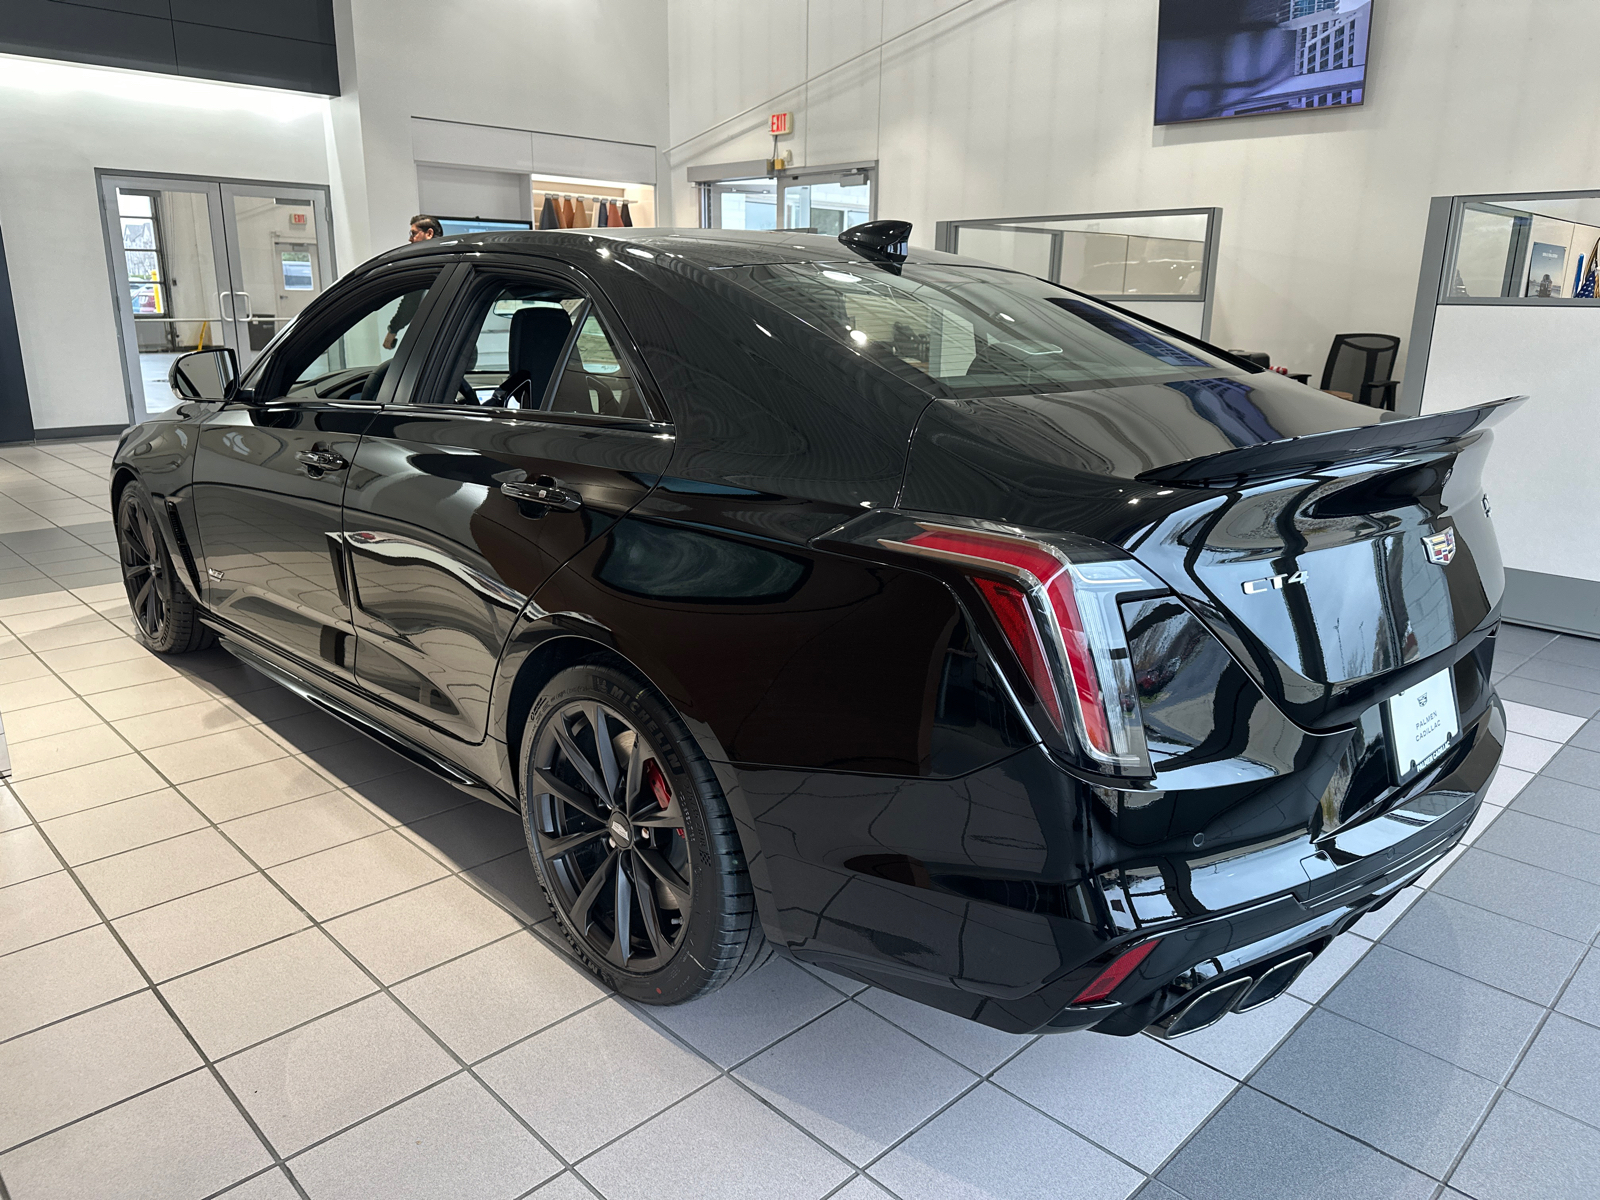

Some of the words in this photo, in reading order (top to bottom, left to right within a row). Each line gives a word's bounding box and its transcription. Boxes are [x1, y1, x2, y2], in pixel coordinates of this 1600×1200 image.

[771, 113, 787, 132] EXIT
[1241, 570, 1309, 595] CT4
[610, 685, 682, 770] MICHELIN
[1415, 719, 1441, 742] CADILLAC
[542, 890, 599, 976] MICHELIN
